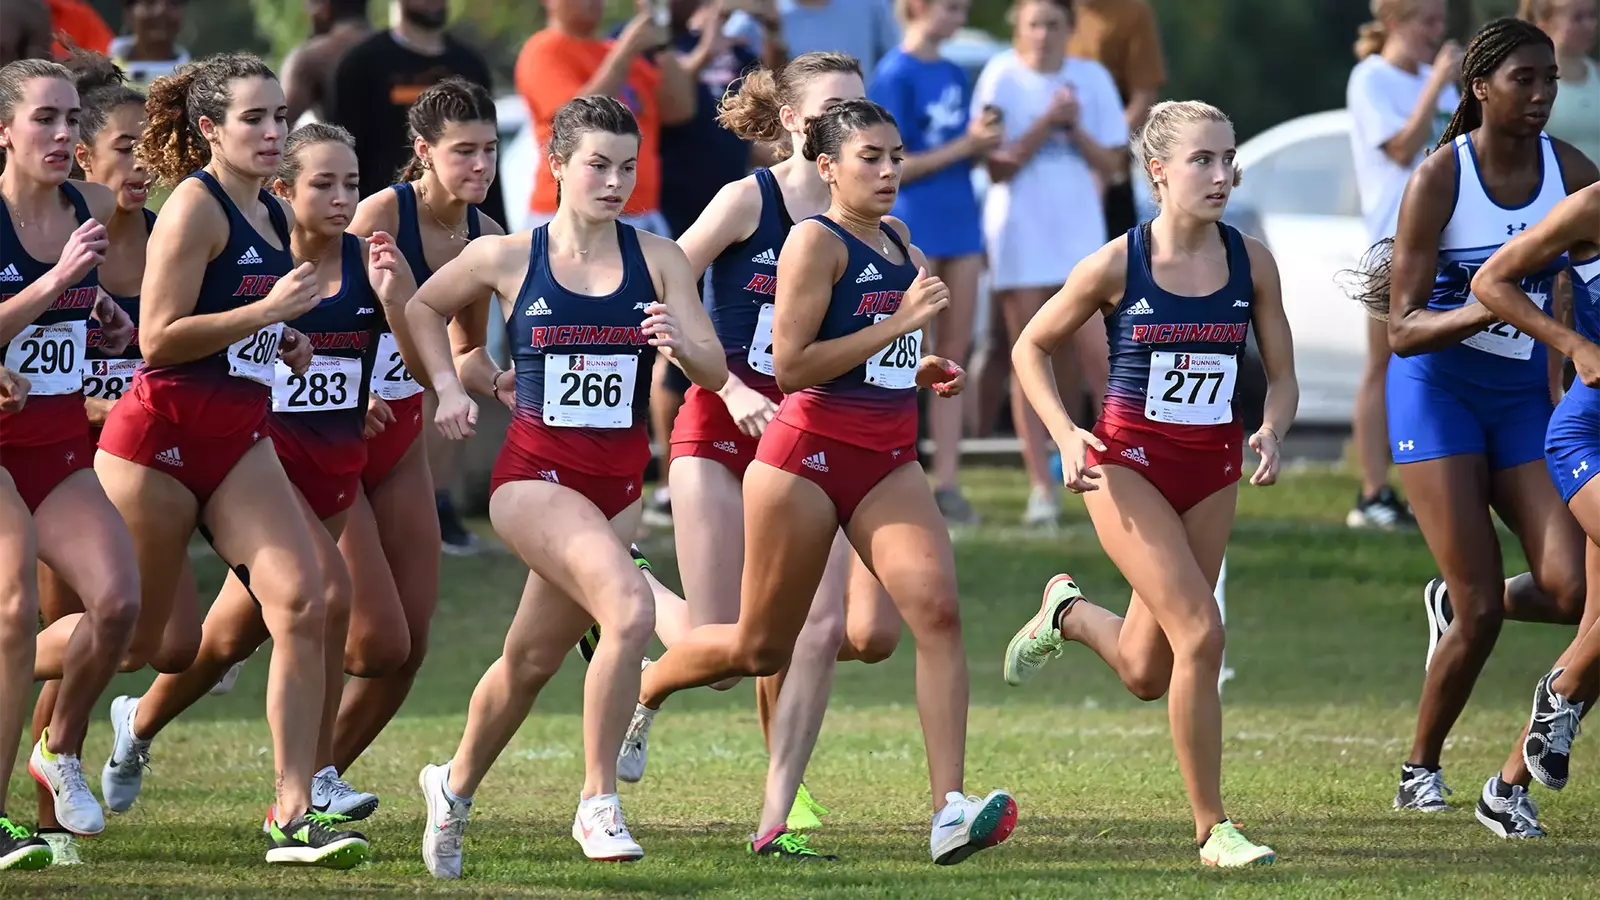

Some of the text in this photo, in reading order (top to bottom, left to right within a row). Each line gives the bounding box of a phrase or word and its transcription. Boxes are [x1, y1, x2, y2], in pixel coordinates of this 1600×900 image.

[237, 255, 263, 265] adidas
[855, 273, 883, 284] adidas
[356, 307, 375, 315] A10
[853, 290, 905, 316] RICH
[1127, 307, 1154, 315] adidas
[525, 308, 552, 316] adidas
[1132, 322, 1248, 344] RICHMOND
[236, 330, 277, 365] 280
[879, 335, 917, 369] 289
[19, 339, 75, 374] 290
[586, 360, 618, 368] RUNNING
[1191, 359, 1221, 367] RUNNING
[286, 372, 347, 407] 283
[559, 372, 623, 407] 266
[1162, 370, 1225, 405] 277
[713, 441, 738, 454] adidas
[155, 454, 184, 467] adidas
[801, 457, 829, 473] adidas
[1121, 450, 1149, 467] adidas
